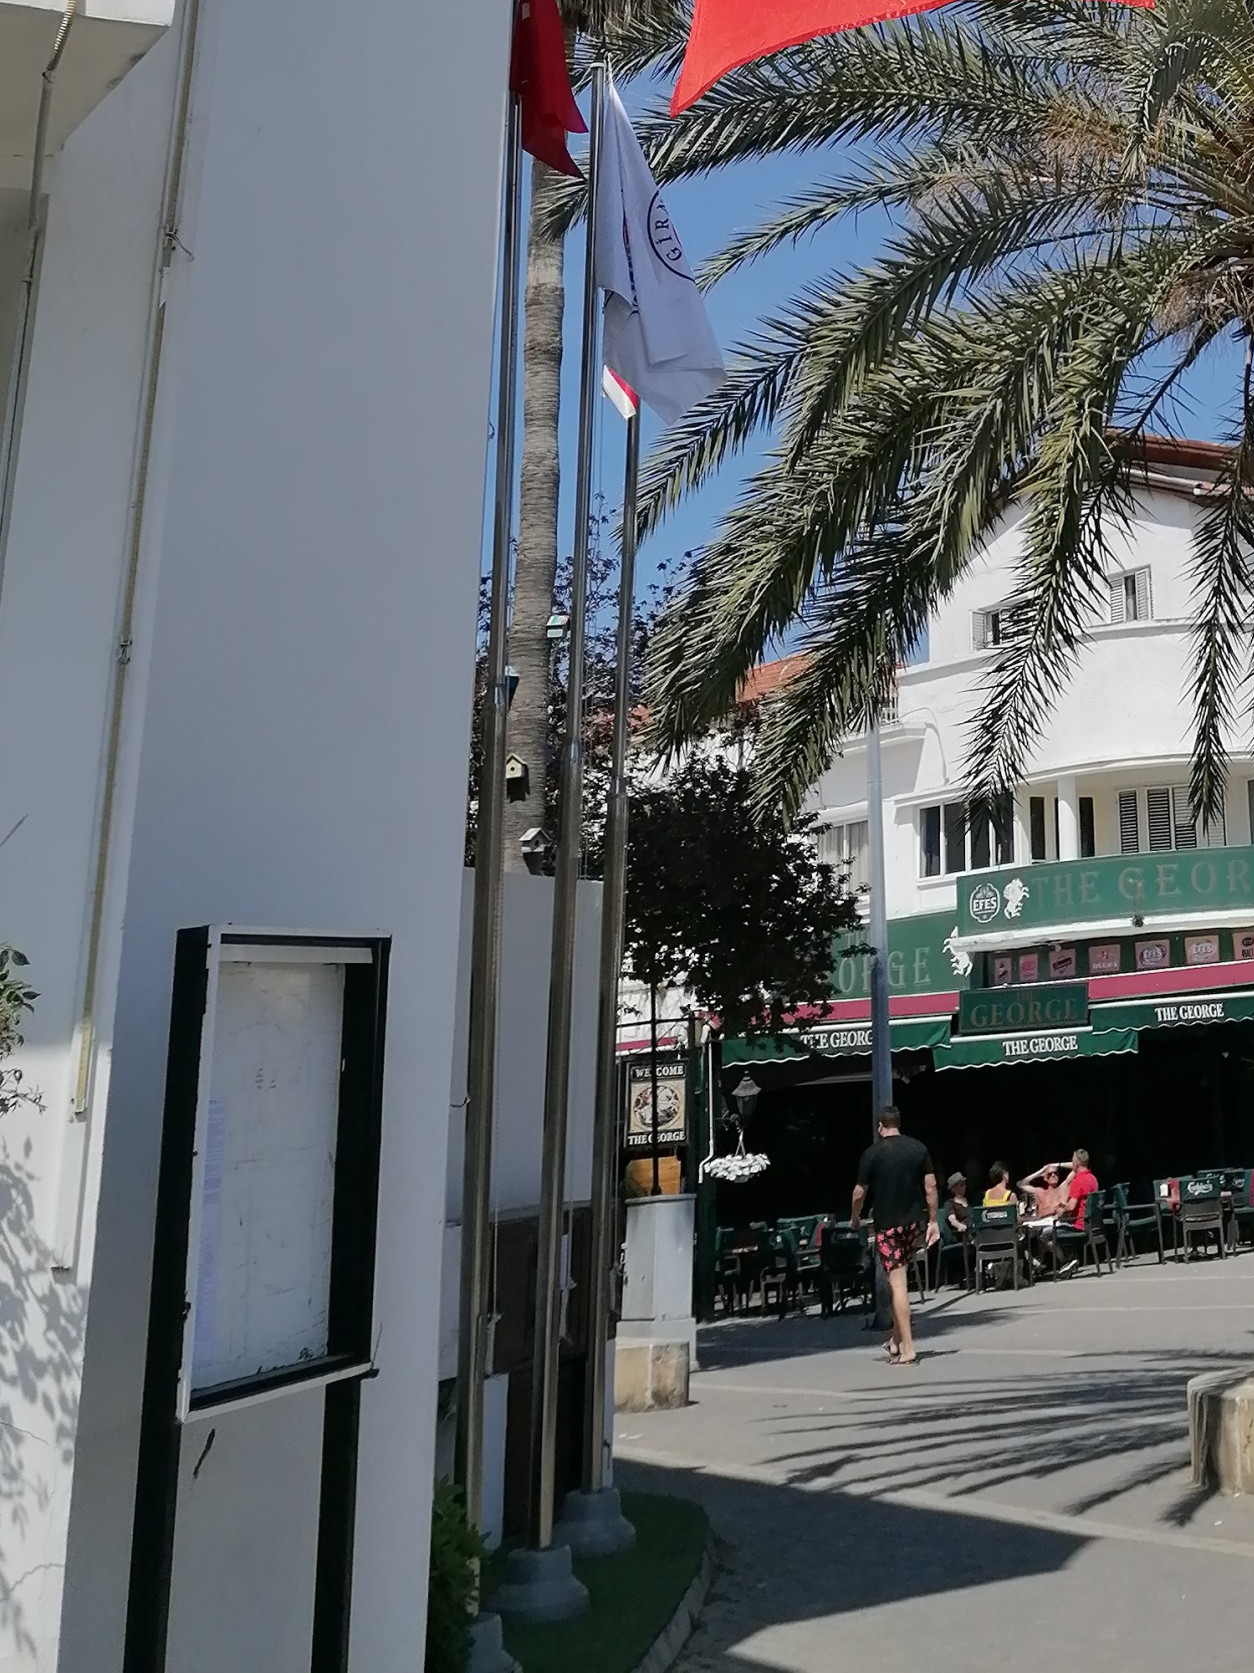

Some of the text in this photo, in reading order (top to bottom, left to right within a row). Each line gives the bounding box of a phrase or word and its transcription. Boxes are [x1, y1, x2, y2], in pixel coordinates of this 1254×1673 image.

[1033, 871, 1100, 909] THE
[973, 895, 997, 911] EFES
[970, 997, 1078, 1028] GEORGE
[1154, 1003, 1225, 1022] THE GEORGE
[829, 1029, 873, 1048] GEORG
[1002, 1035, 1078, 1056] THE GEORGE
[635, 1065, 684, 1078] WECOME
[628, 1134, 648, 1145] THE
